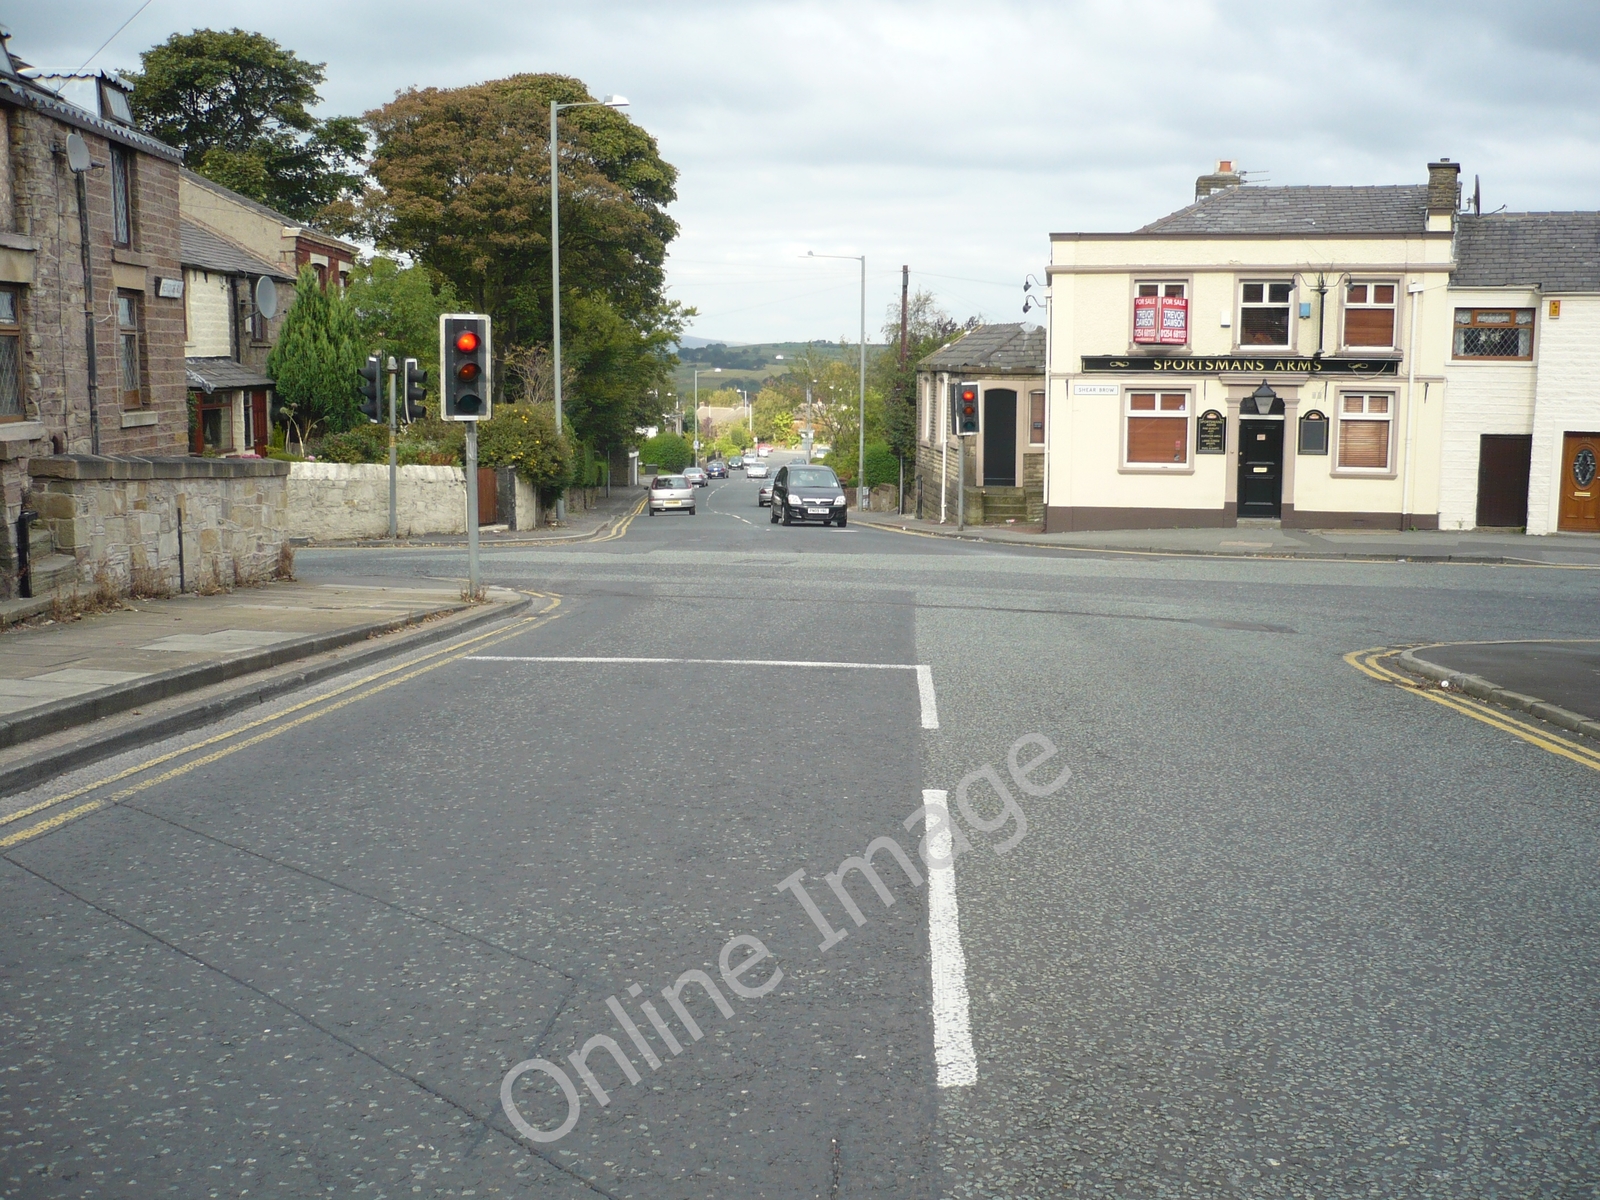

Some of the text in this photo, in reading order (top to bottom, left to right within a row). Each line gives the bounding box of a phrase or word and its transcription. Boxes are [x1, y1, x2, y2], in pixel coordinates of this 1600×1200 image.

[1136, 310, 1154, 318] TREVOR
[1163, 310, 1185, 319] TREVOR
[1153, 359, 1323, 372] SPORTSMANS ARMS
